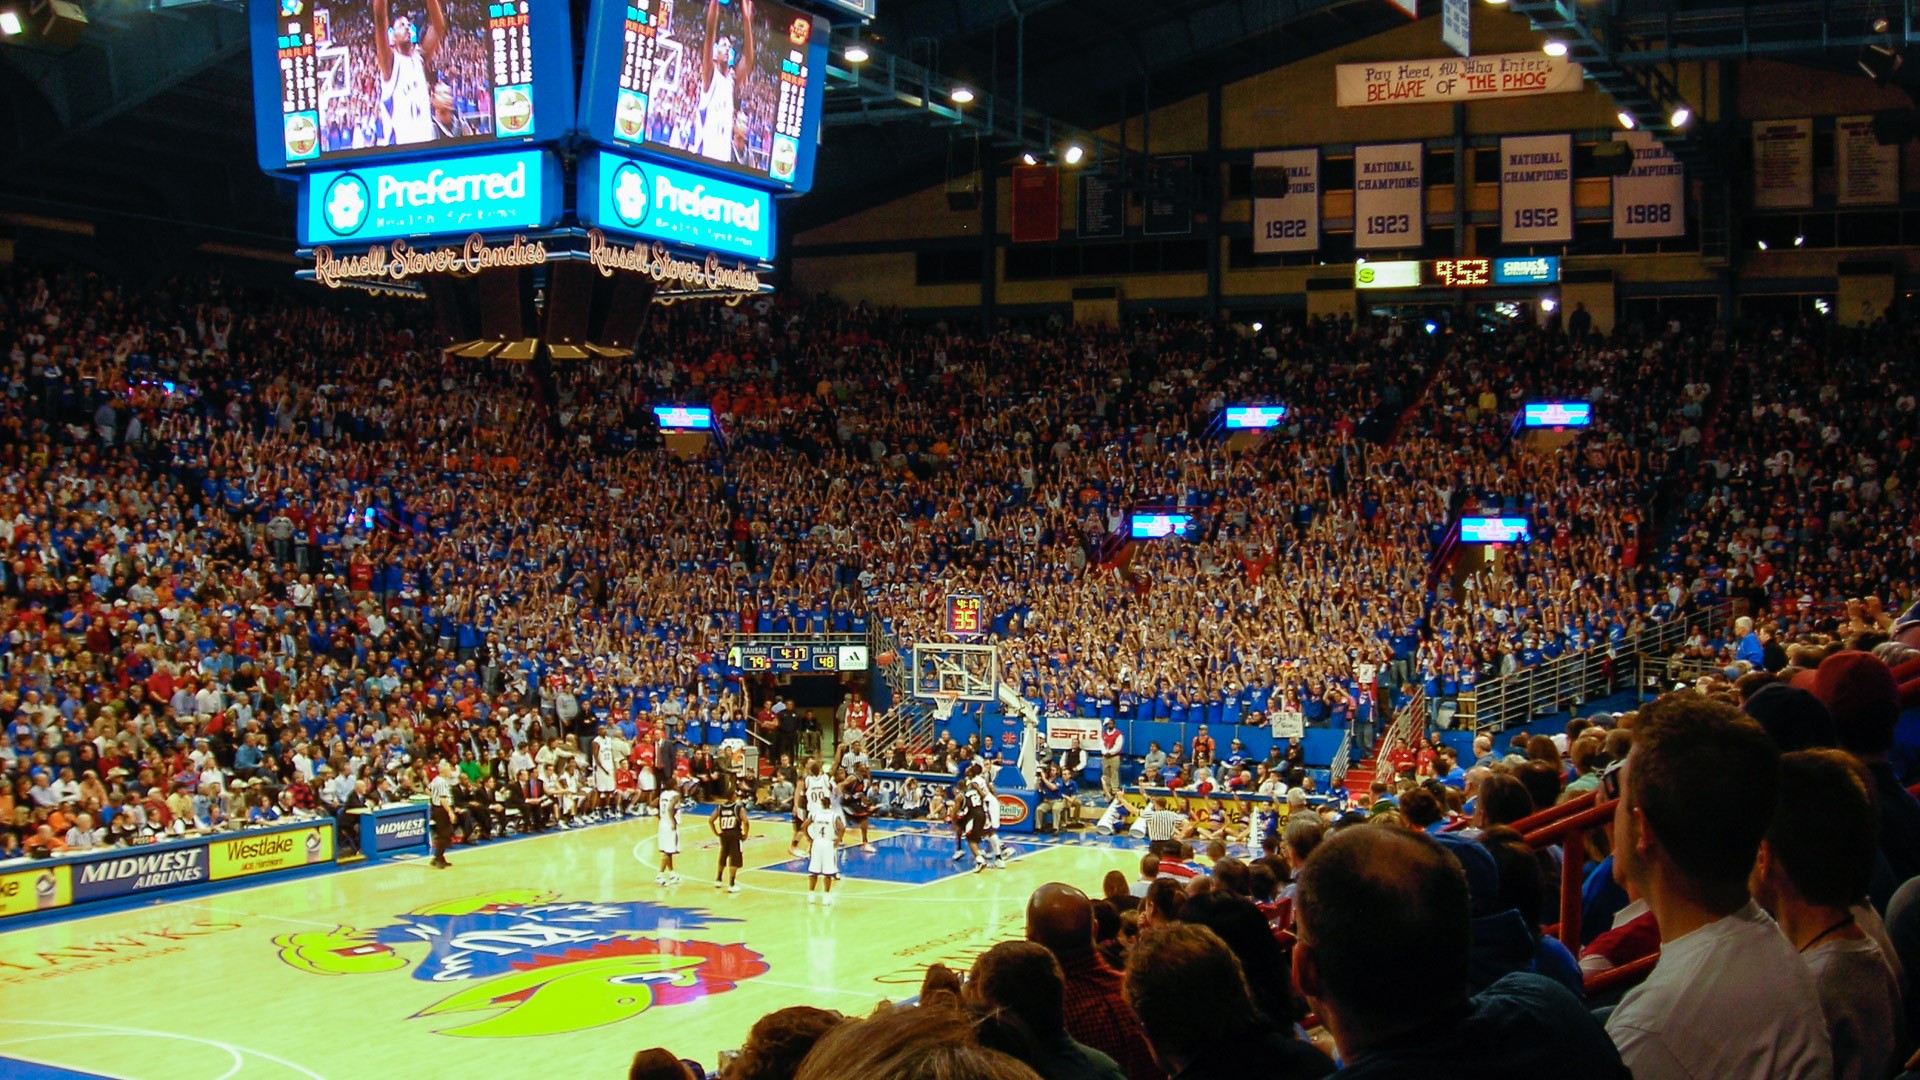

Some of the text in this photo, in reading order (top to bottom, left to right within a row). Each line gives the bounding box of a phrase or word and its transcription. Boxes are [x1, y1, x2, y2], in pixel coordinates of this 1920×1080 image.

[1365, 67, 1392, 82] Pay
[1398, 65, 1433, 80] Heed,
[1439, 61, 1458, 75] All
[1367, 80, 1426, 103] BEWARE
[1436, 79, 1458, 95] OF
[1363, 160, 1414, 174] NATIONAL
[1509, 152, 1562, 166] NATIONAL
[1284, 167, 1311, 177] ONAL
[1504, 168, 1568, 183] CHAMPIONS
[1629, 163, 1682, 177] AMPIONS
[377, 161, 526, 209] Preferred
[1357, 177, 1419, 191] CHAMPIONS
[655, 175, 760, 232] Preferred
[1626, 203, 1671, 224] 1988
[1367, 214, 1409, 235] 1923
[1514, 207, 1558, 228] 1952
[1265, 219, 1307, 239] 1922
[313, 245, 387, 288] Russell
[389, 238, 462, 280] Stover
[464, 233, 546, 274] Candies
[587, 228, 759, 292] Russell Stover Candies
[1436, 259, 1489, 286] 9:52
[957, 599, 979, 610] 4:17
[955, 610, 976, 630] 35
[742, 647, 767, 655] KANSAS
[781, 648, 806, 659] 4:17
[750, 657, 764, 668] 79
[792, 661, 799, 671] 2
[819, 656, 834, 668] 48
[1000, 804, 1021, 816] Reilly
[375, 818, 425, 836] MIDWEST
[227, 834, 293, 861] Westlake
[80, 849, 203, 884] MIDWEST
[132, 867, 202, 890] AIRLINES
